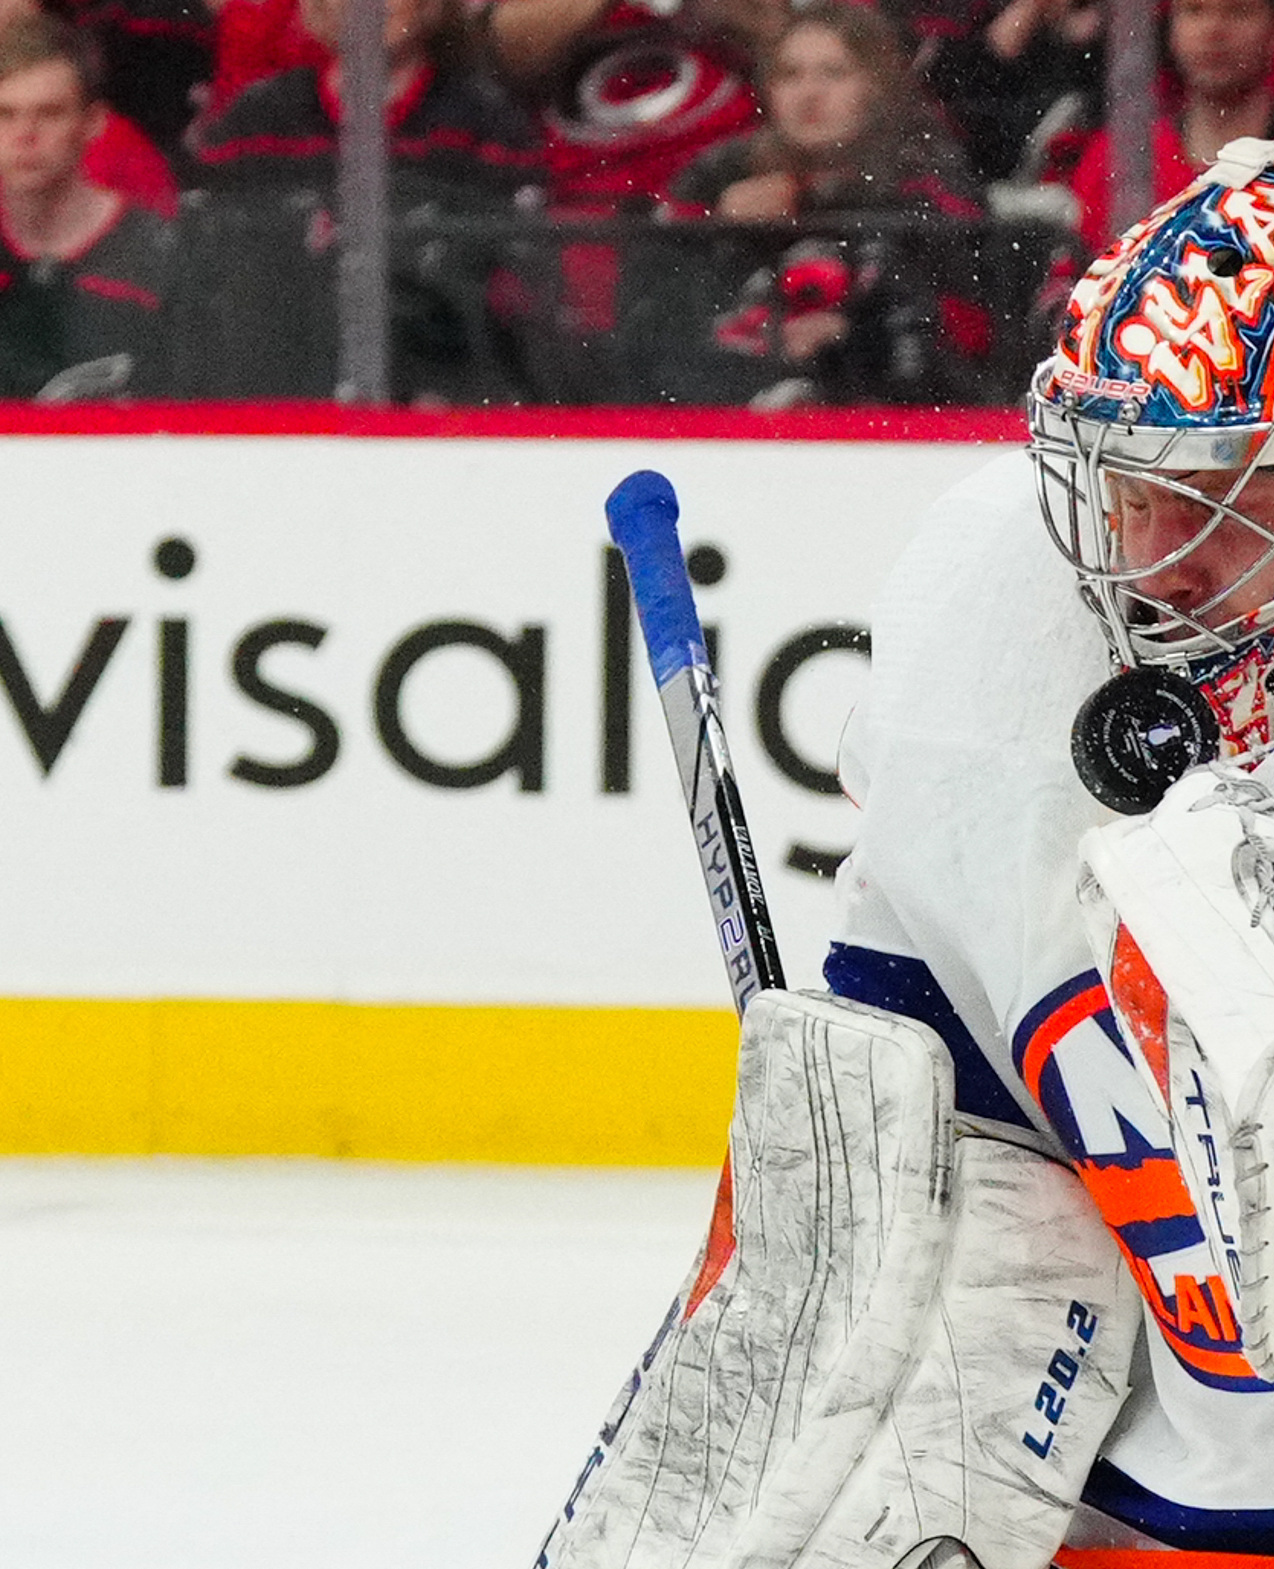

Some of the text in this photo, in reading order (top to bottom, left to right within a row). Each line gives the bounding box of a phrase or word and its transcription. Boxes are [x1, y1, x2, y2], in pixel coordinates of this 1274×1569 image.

[1060, 370, 1152, 404] BAUER
[1103, 708, 1139, 784] OFFICIAL GAME PUCK
[1186, 1068, 1242, 1300] TRUE
[1022, 1299, 1099, 1460] L20.2
